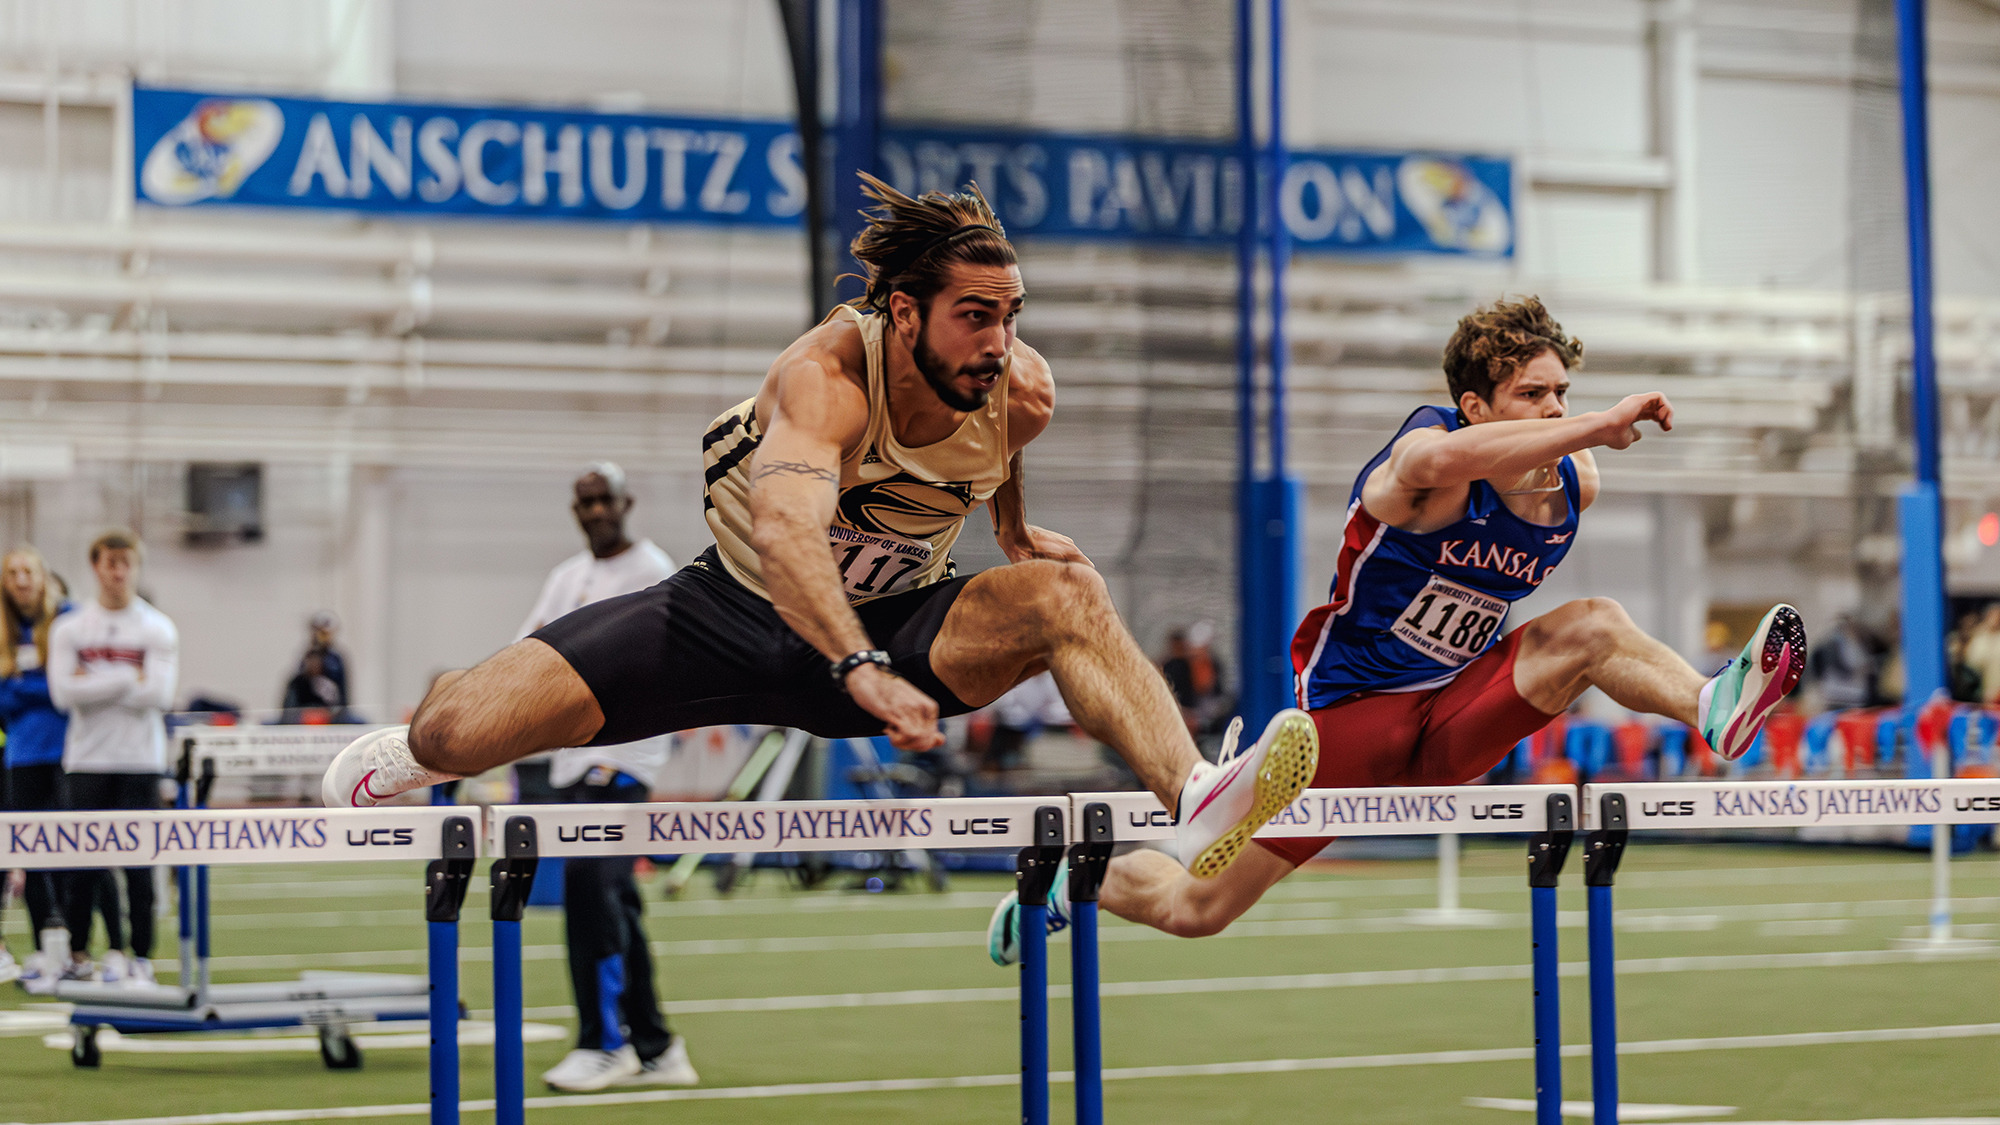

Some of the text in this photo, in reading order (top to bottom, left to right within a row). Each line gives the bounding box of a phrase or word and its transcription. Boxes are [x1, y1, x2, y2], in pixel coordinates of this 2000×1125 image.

[289, 113, 750, 215] ANSCHUTZ
[830, 542, 922, 594] 117
[880, 539, 897, 551] OF
[893, 543, 930, 560] KANSAS
[1431, 581, 1473, 604] UNIVERSITY
[1398, 626, 1434, 651] JAYHAWK
[1404, 593, 1499, 654] 1188
[1318, 795, 1457, 833] JAYHAWKS
[1471, 804, 1524, 820] UCS
[1642, 787, 2000, 822] UCS KANSAS JAYHAWKS UCS
[9, 818, 415, 860] KANSAS JAYHAWKS UCS
[558, 808, 1011, 849] UCS KANSAS JAYHAWKS UCS
